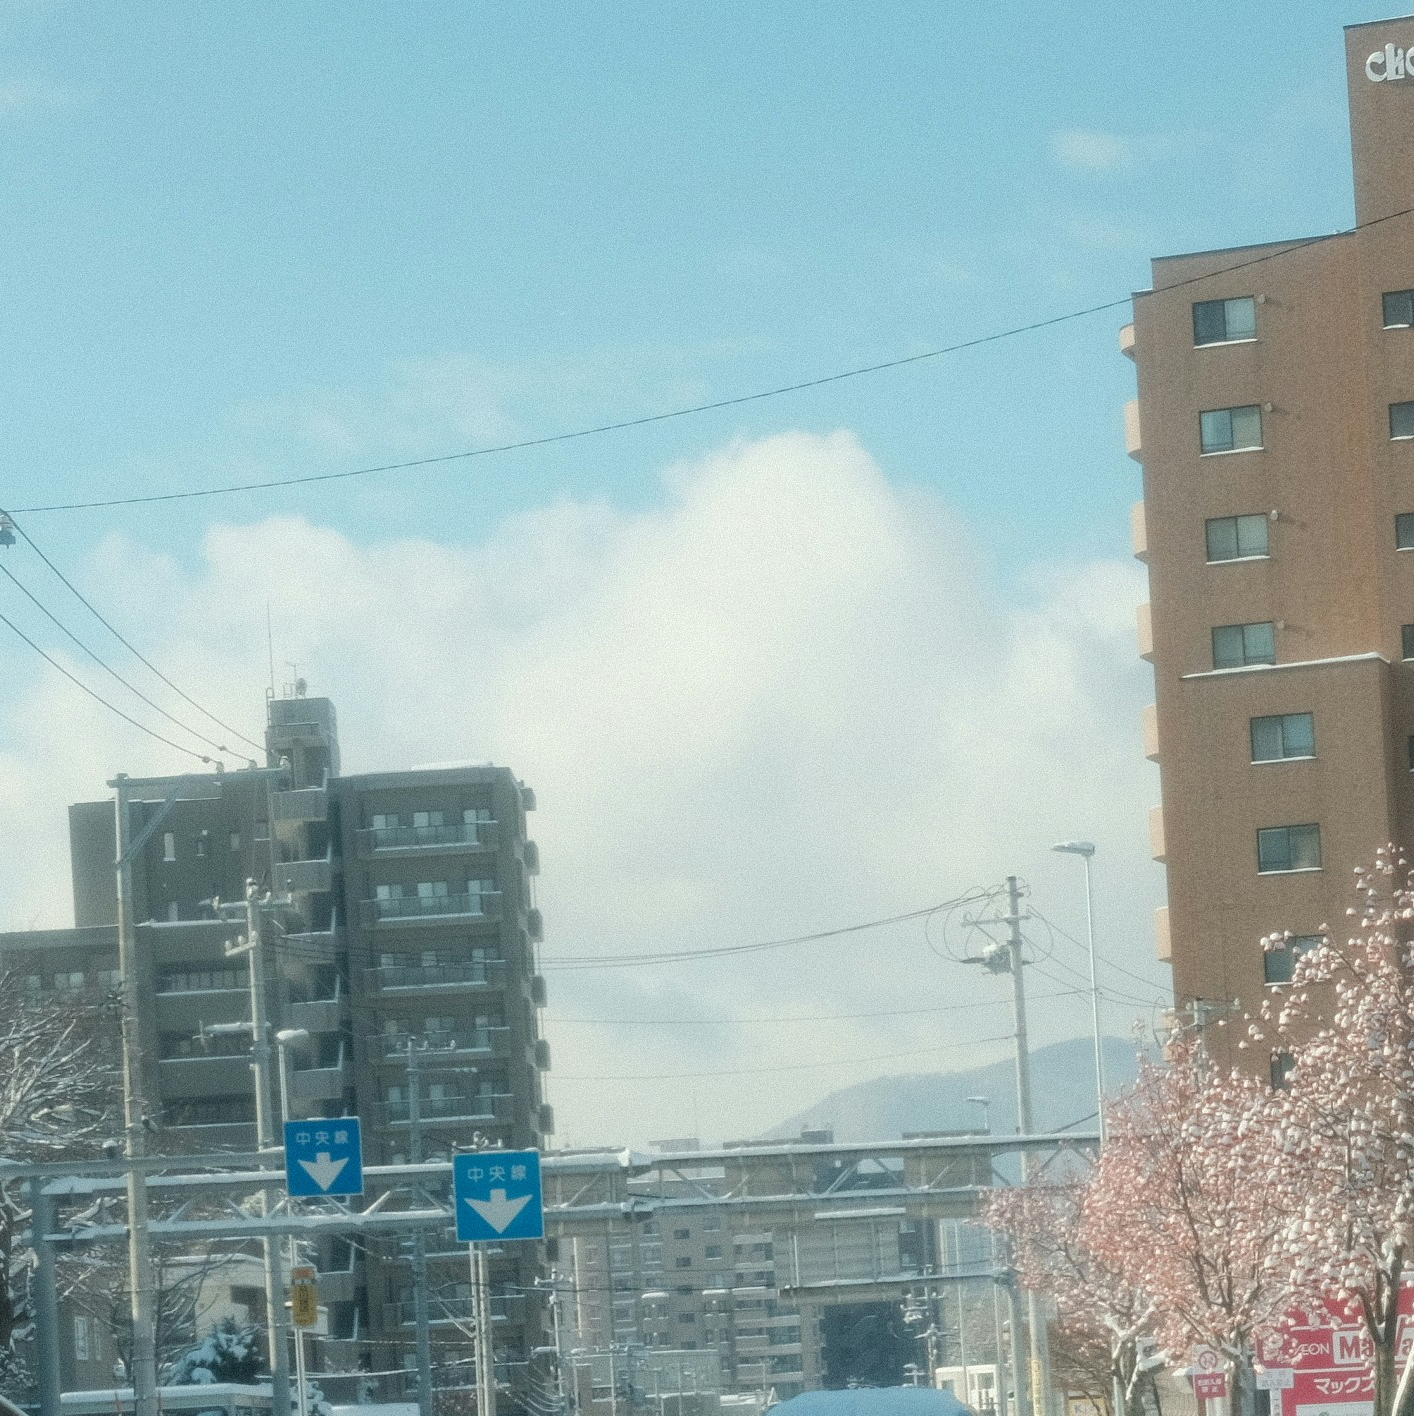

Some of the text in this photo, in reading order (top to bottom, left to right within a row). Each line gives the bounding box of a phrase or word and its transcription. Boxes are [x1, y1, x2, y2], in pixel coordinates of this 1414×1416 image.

[296, 1131, 348, 1146] 中央線
[467, 1165, 527, 1182] 中央線
